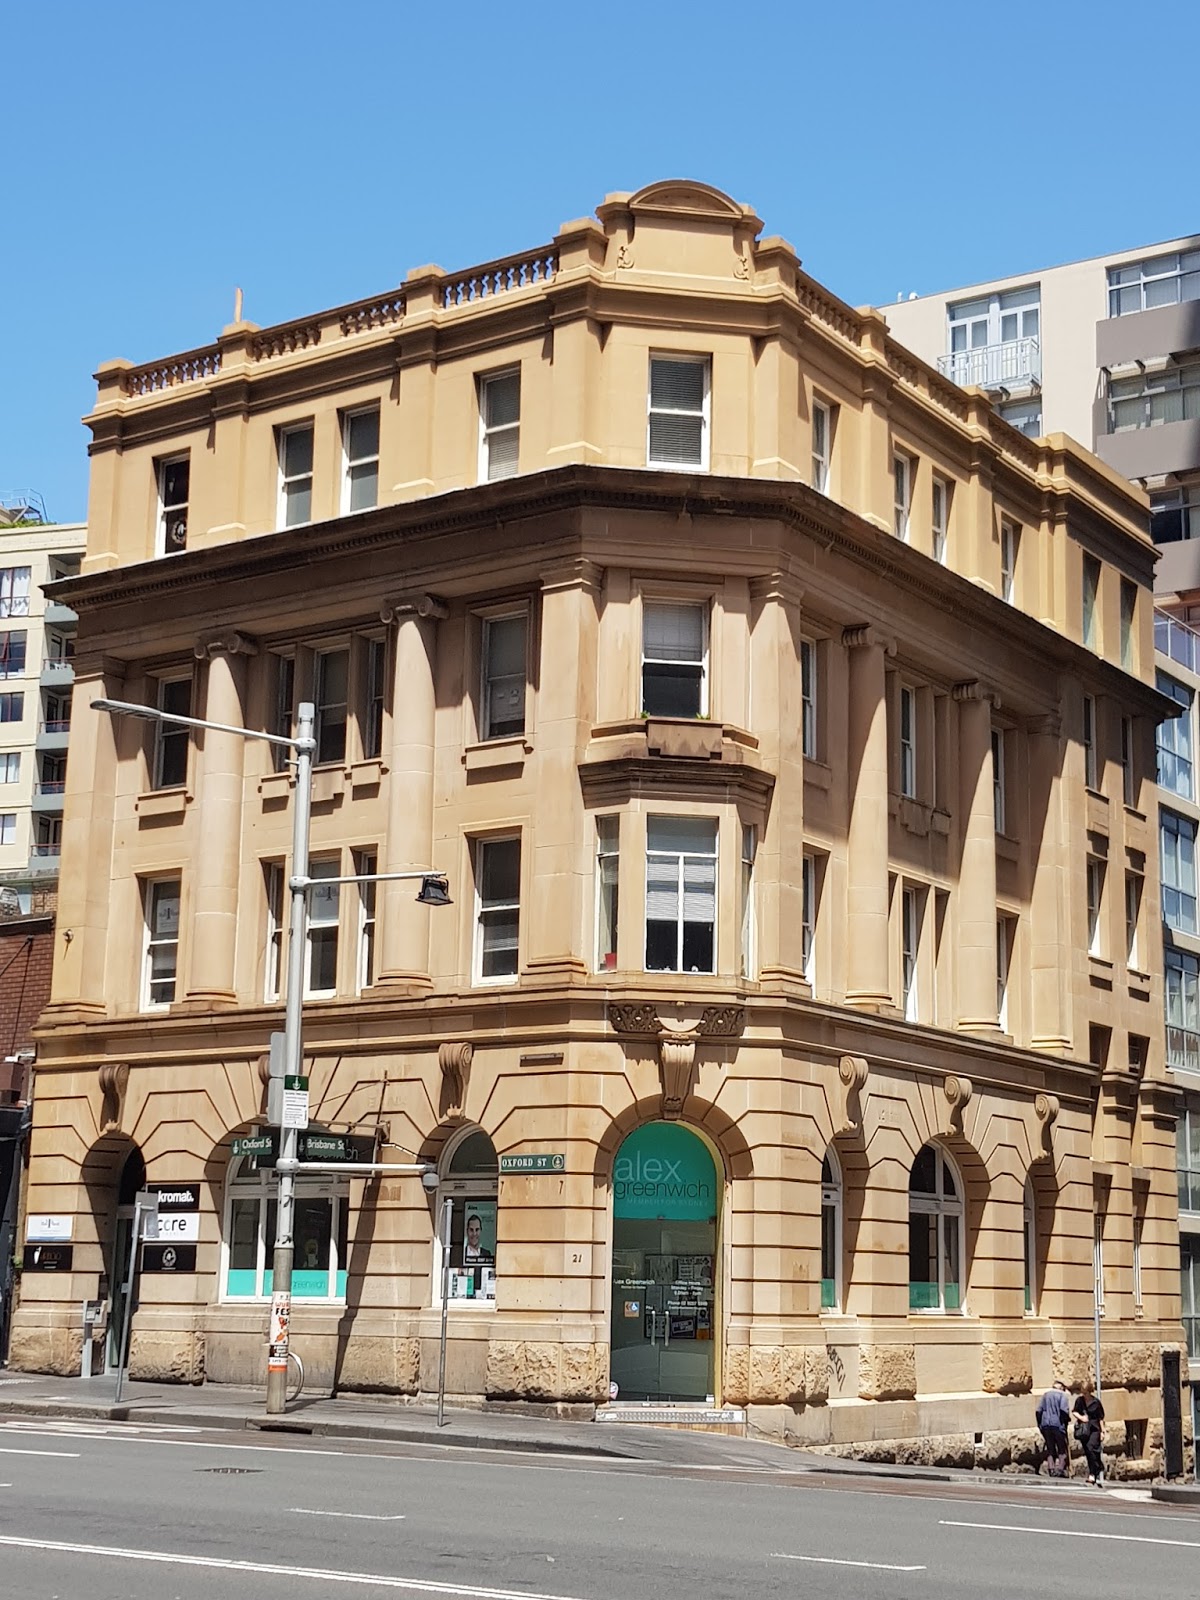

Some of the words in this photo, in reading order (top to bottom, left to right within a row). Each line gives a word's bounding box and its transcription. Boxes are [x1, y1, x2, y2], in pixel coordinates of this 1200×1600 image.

[242, 1138, 265, 1149] Oxford
[265, 1137, 273, 1148] St
[307, 1138, 336, 1150] Brisbane
[337, 1139, 345, 1150] St
[502, 1158, 533, 1168] OXFORD
[536, 1158, 547, 1167] ST
[615, 1150, 682, 1182] alex
[615, 1180, 709, 1200] greenwich
[572, 1254, 582, 1263] 21
